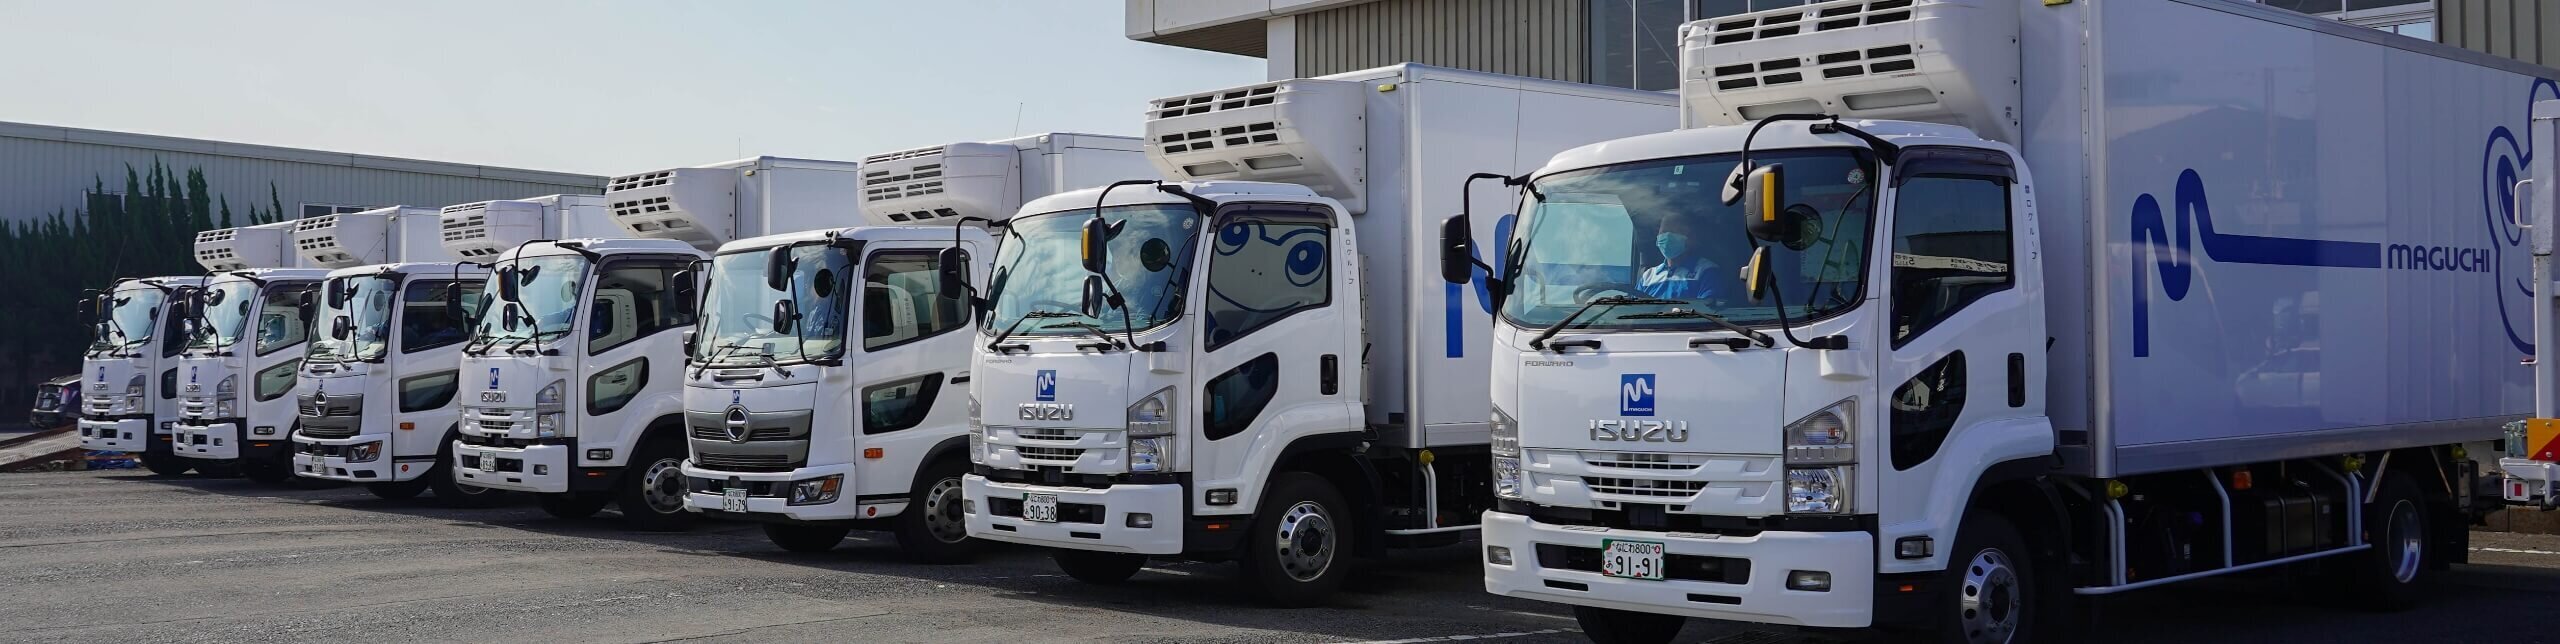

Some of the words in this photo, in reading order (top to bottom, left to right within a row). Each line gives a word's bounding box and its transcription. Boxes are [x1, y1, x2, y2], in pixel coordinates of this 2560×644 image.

[2388, 243, 2490, 272] MAGUCHI
[1018, 403, 1074, 421] ISUZU
[1589, 418, 1689, 442] ISUZU
[727, 498, 746, 511] 91-79
[1029, 504, 1055, 521] 90-38
[1615, 555, 1659, 578] 91-91
